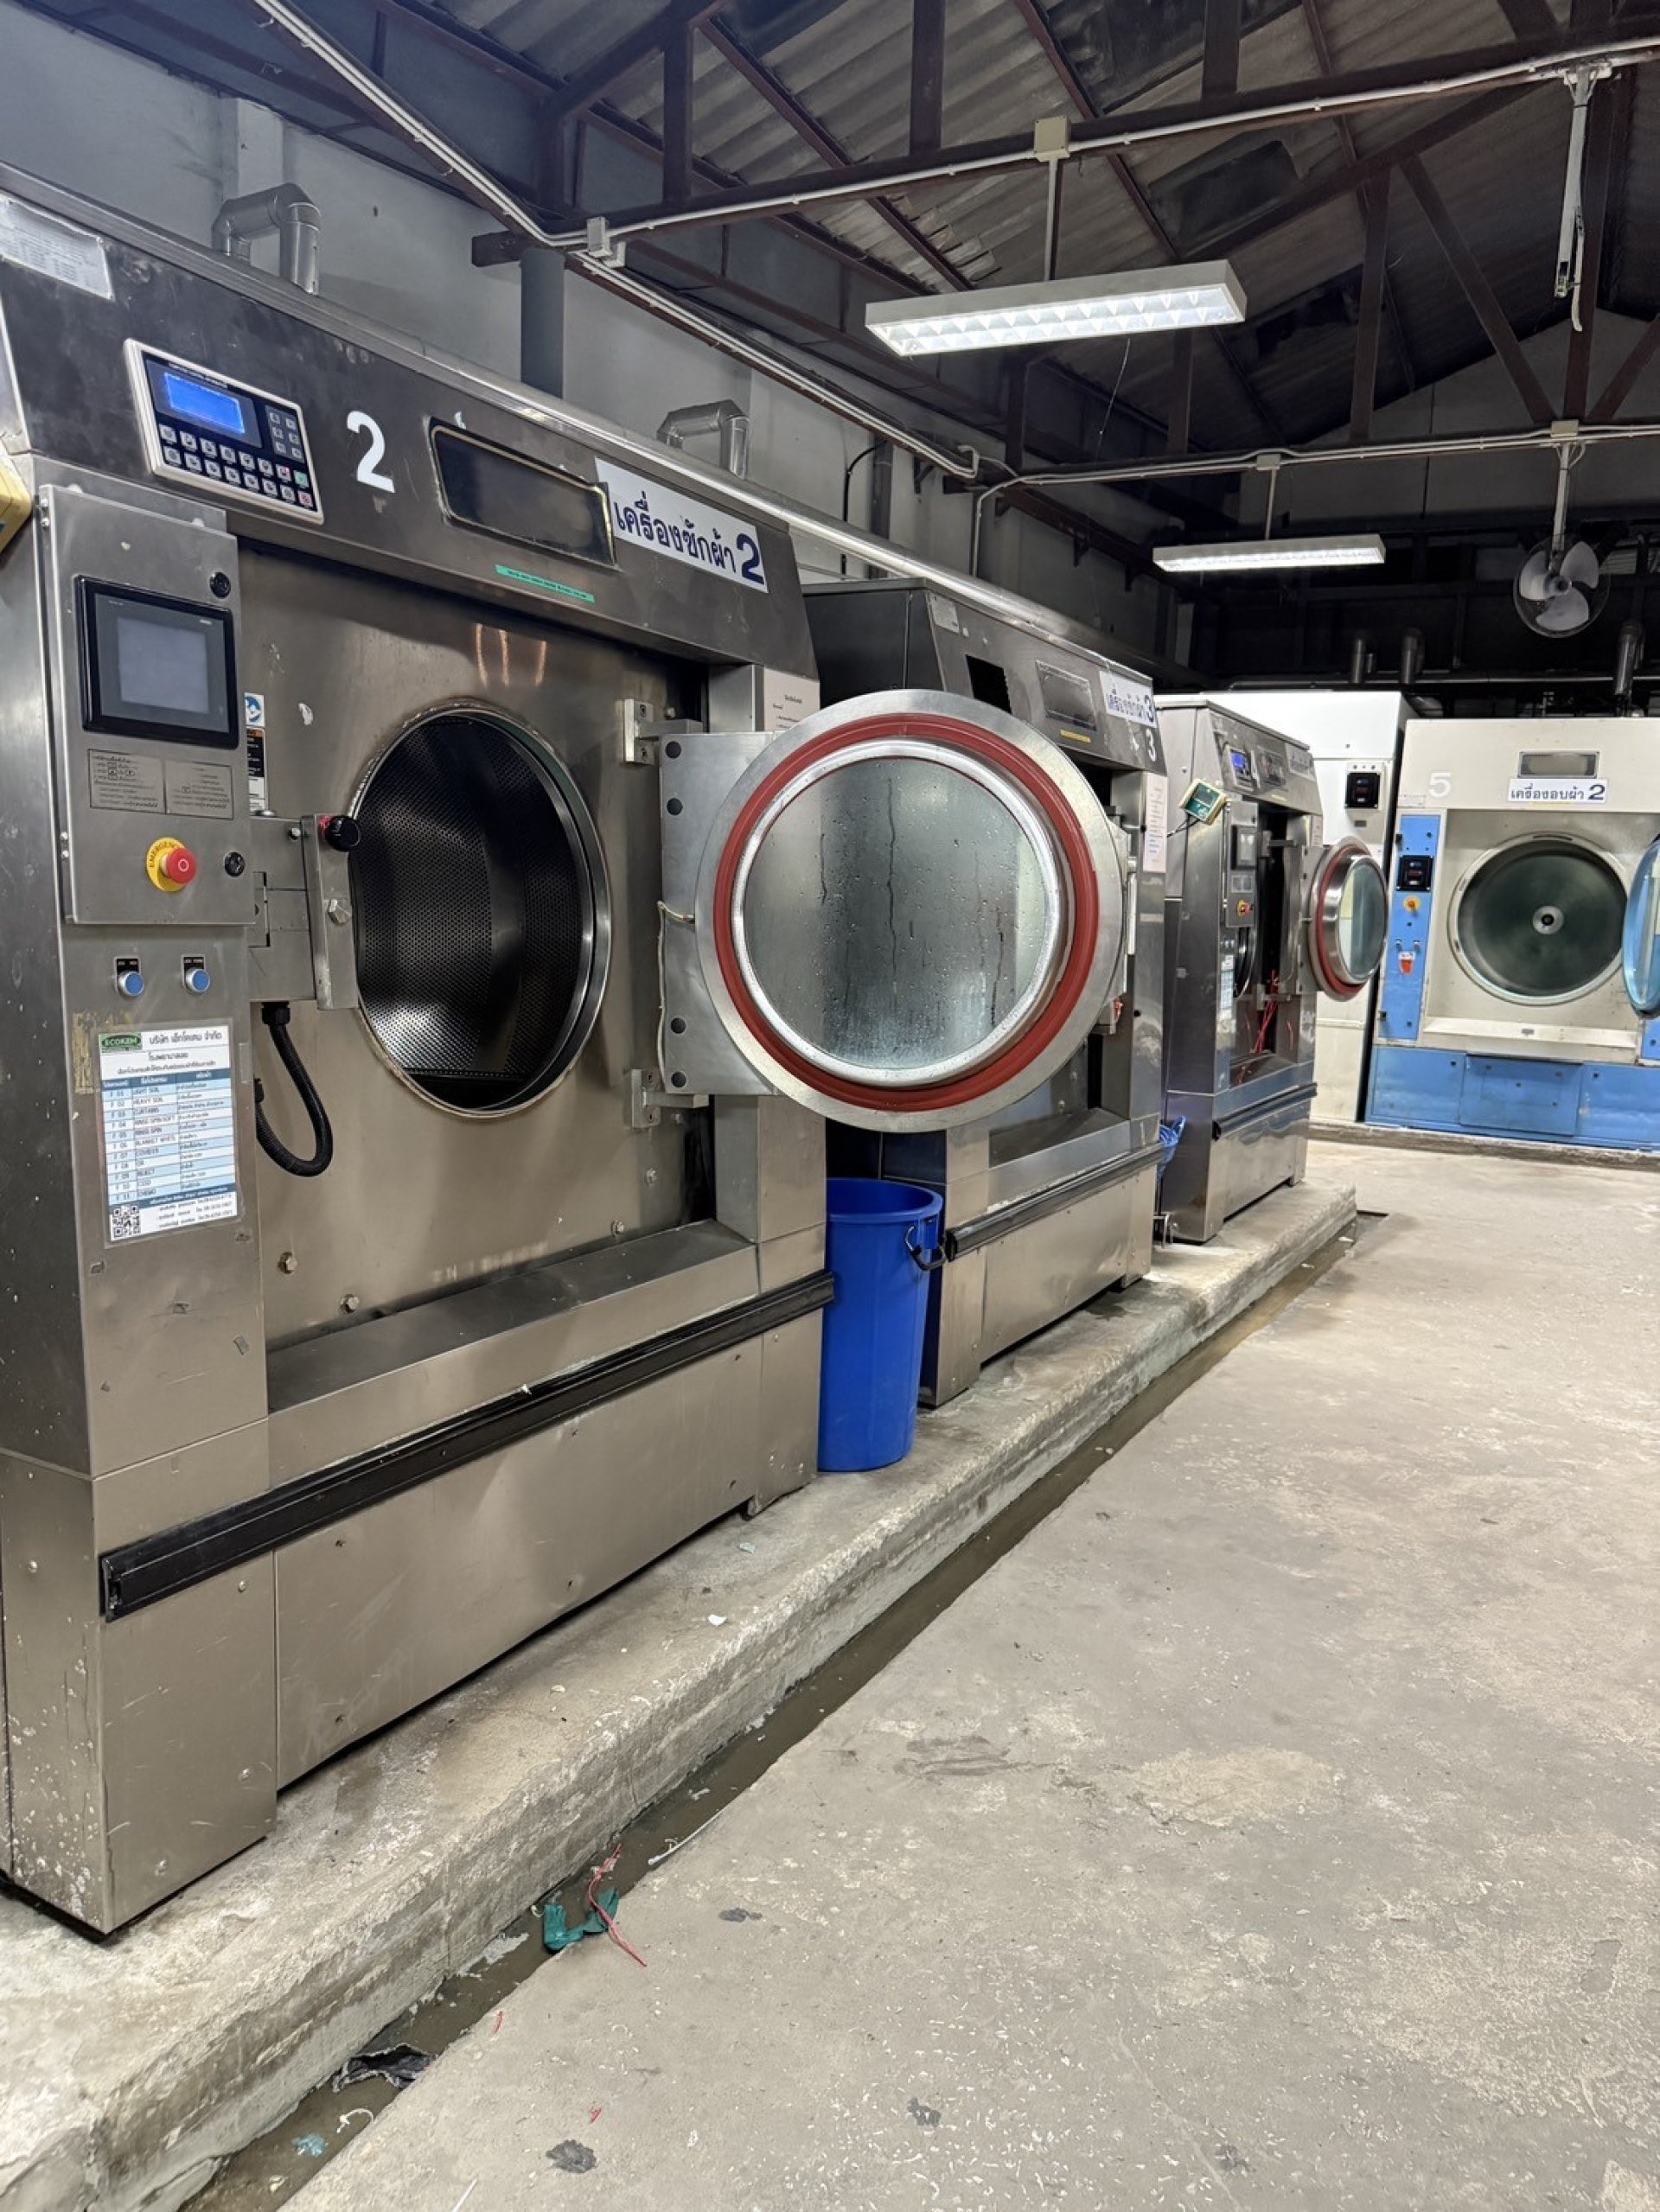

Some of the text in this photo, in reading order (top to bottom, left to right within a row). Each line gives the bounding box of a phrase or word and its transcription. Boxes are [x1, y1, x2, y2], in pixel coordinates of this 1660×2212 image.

[347, 411, 395, 494] 2
[614, 490, 765, 585] เครื่องซักผ้า 2
[1146, 729, 1157, 762] 3
[1428, 772, 1452, 798] 5
[1511, 783, 1606, 800] เครื่องอบผ้า 2
